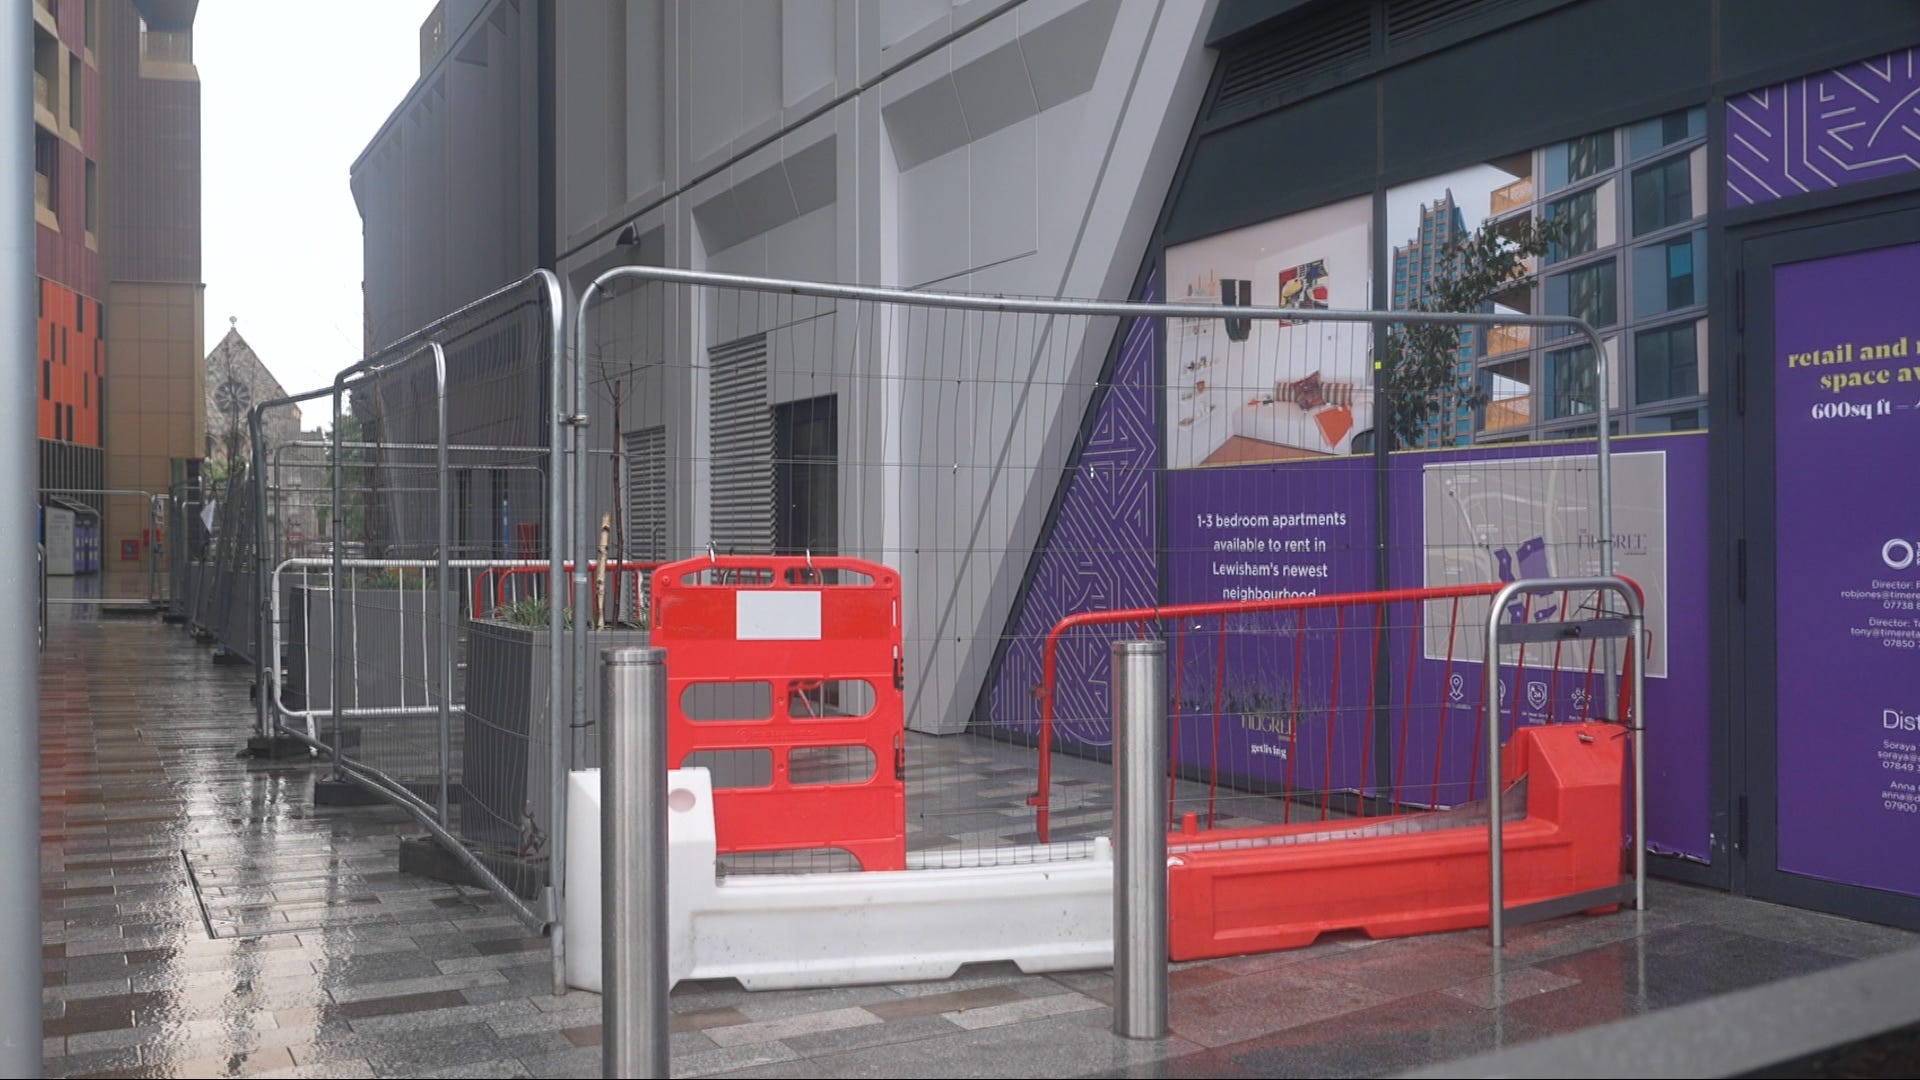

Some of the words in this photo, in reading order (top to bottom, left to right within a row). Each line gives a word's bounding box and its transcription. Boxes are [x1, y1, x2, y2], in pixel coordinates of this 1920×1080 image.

[1788, 343, 1852, 368] retail
[1859, 336, 1908, 361] and
[1820, 369, 1890, 394] space
[1811, 401, 1873, 420] 600sq
[1876, 398, 1891, 416] ft
[1197, 514, 1213, 527] 1-3
[1216, 513, 1269, 527] bedroom
[1272, 511, 1347, 528] apartments
[1213, 537, 1265, 552] available
[1268, 538, 1281, 552] to
[1285, 538, 1310, 552] rent
[1314, 537, 1326, 552] in
[1212, 561, 1279, 576] Lewisham's
[1282, 563, 1328, 577] newest
[1872, 579, 1913, 590] Director:
[1868, 617, 1911, 627] Director:
[1883, 638, 1915, 648] 07850
[1883, 739, 1916, 752] Soraya
[1882, 760, 1914, 771] 07849
[1890, 780, 1916, 791] Anna
